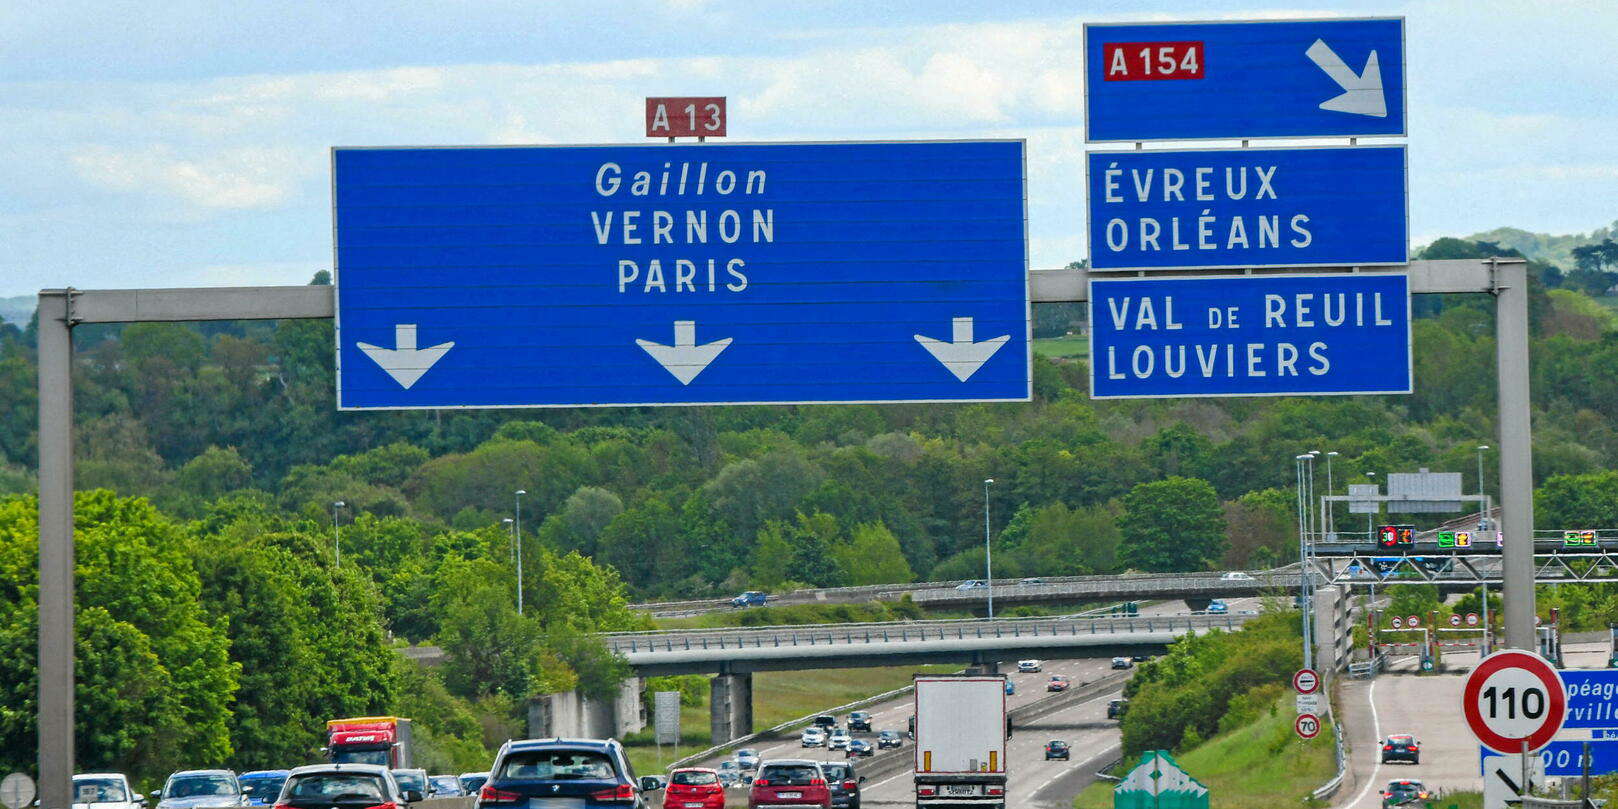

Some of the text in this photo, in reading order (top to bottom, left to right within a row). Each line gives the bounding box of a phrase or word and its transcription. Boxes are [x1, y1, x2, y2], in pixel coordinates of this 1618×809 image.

[1110, 46, 1199, 76] A 154
[652, 103, 721, 131] A 13
[595, 162, 767, 197] Gaillon
[1105, 163, 1278, 203] ÉVREUX
[591, 209, 774, 245] VERNON
[1106, 209, 1313, 252] ORLÉANS
[618, 258, 748, 293] PARIS
[1108, 292, 1392, 331] VAL DE REUIL
[1108, 341, 1330, 380] LOUVIERS
[1483, 686, 1545, 720] 110
[1567, 679, 1618, 701] péag
[1300, 721, 1316, 732] 70
[1565, 702, 1618, 721] rvill
[1540, 749, 1570, 768] 00
